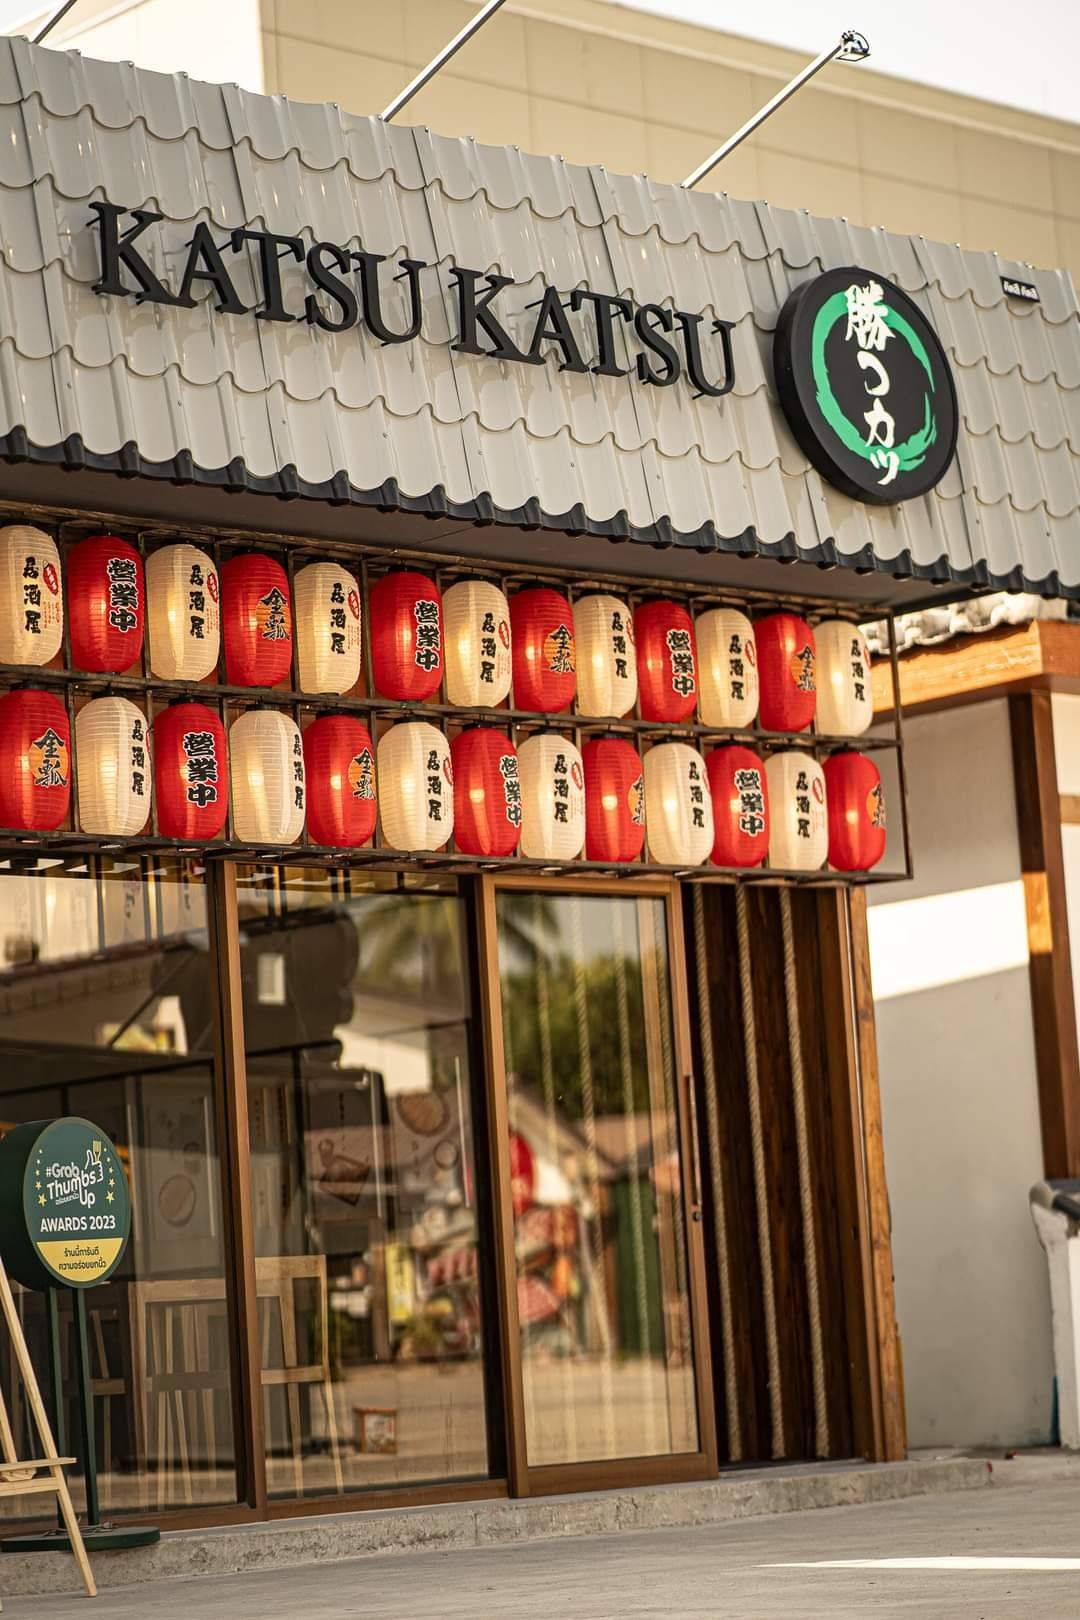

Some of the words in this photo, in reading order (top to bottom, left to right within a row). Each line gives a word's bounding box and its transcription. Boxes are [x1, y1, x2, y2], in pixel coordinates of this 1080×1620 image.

[89, 202, 427, 344] KATSU
[449, 267, 736, 397] KATSU
[23, 556, 41, 634] 居酒屋
[190, 564, 205, 639] 居酒屋
[330, 583, 346, 654] 居酒屋
[480, 613, 496, 683] 居酒屋
[427, 750, 442, 821] 居酒屋
[554, 754, 569, 823] 居酒屋
[46, 1161, 80, 1178] #Grab
[46, 1170, 97, 1200] Thumbs
[80, 1189, 96, 1208] Up
[40, 1217, 88, 1232] AWARDS
[89, 1215, 116, 1230] 2023
